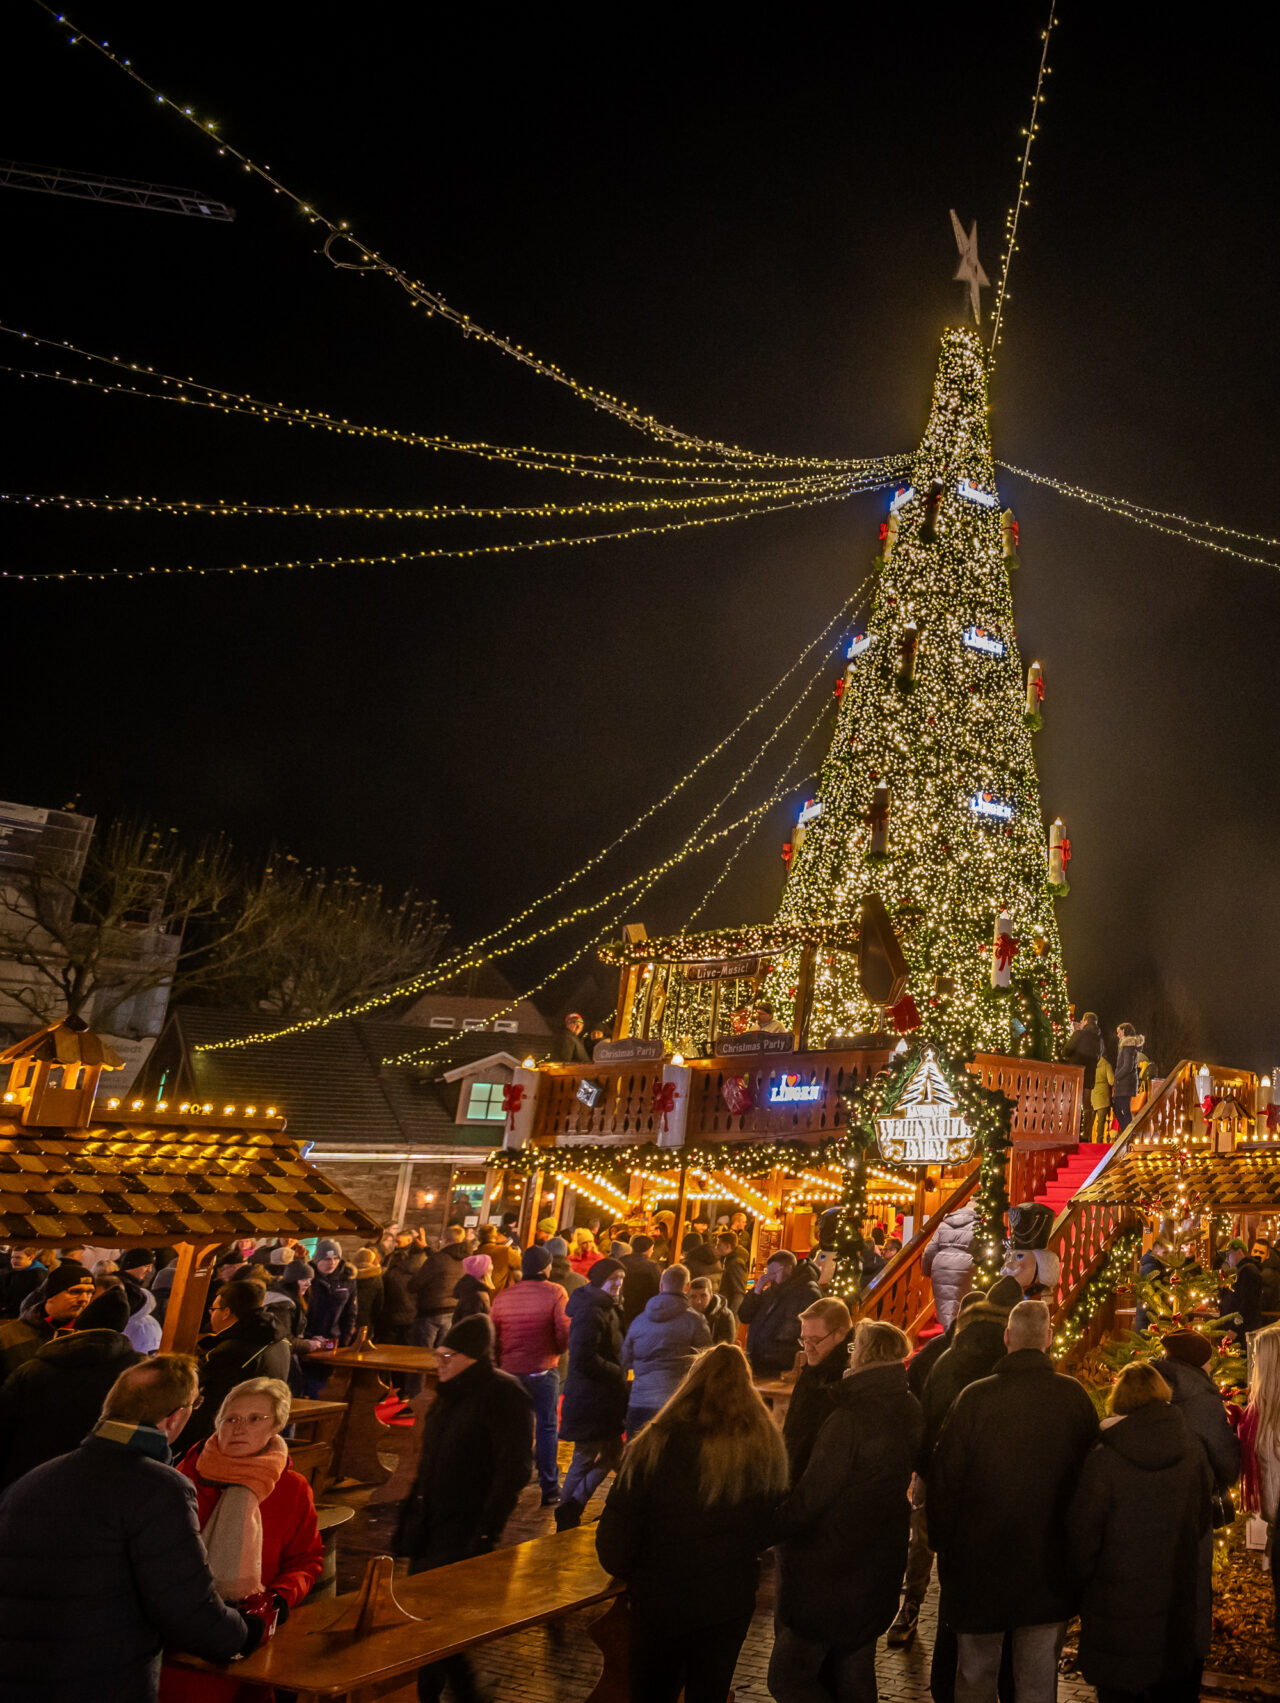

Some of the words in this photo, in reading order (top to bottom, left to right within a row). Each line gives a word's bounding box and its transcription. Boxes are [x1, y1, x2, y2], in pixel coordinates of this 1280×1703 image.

[696, 962, 749, 979] Live-Music!
[600, 1048, 634, 1058] Christmas
[636, 1046, 657, 1058] Party
[722, 1041, 761, 1054] Christmas
[763, 1039, 786, 1051] Party
[902, 1139, 949, 1161] BAUM
